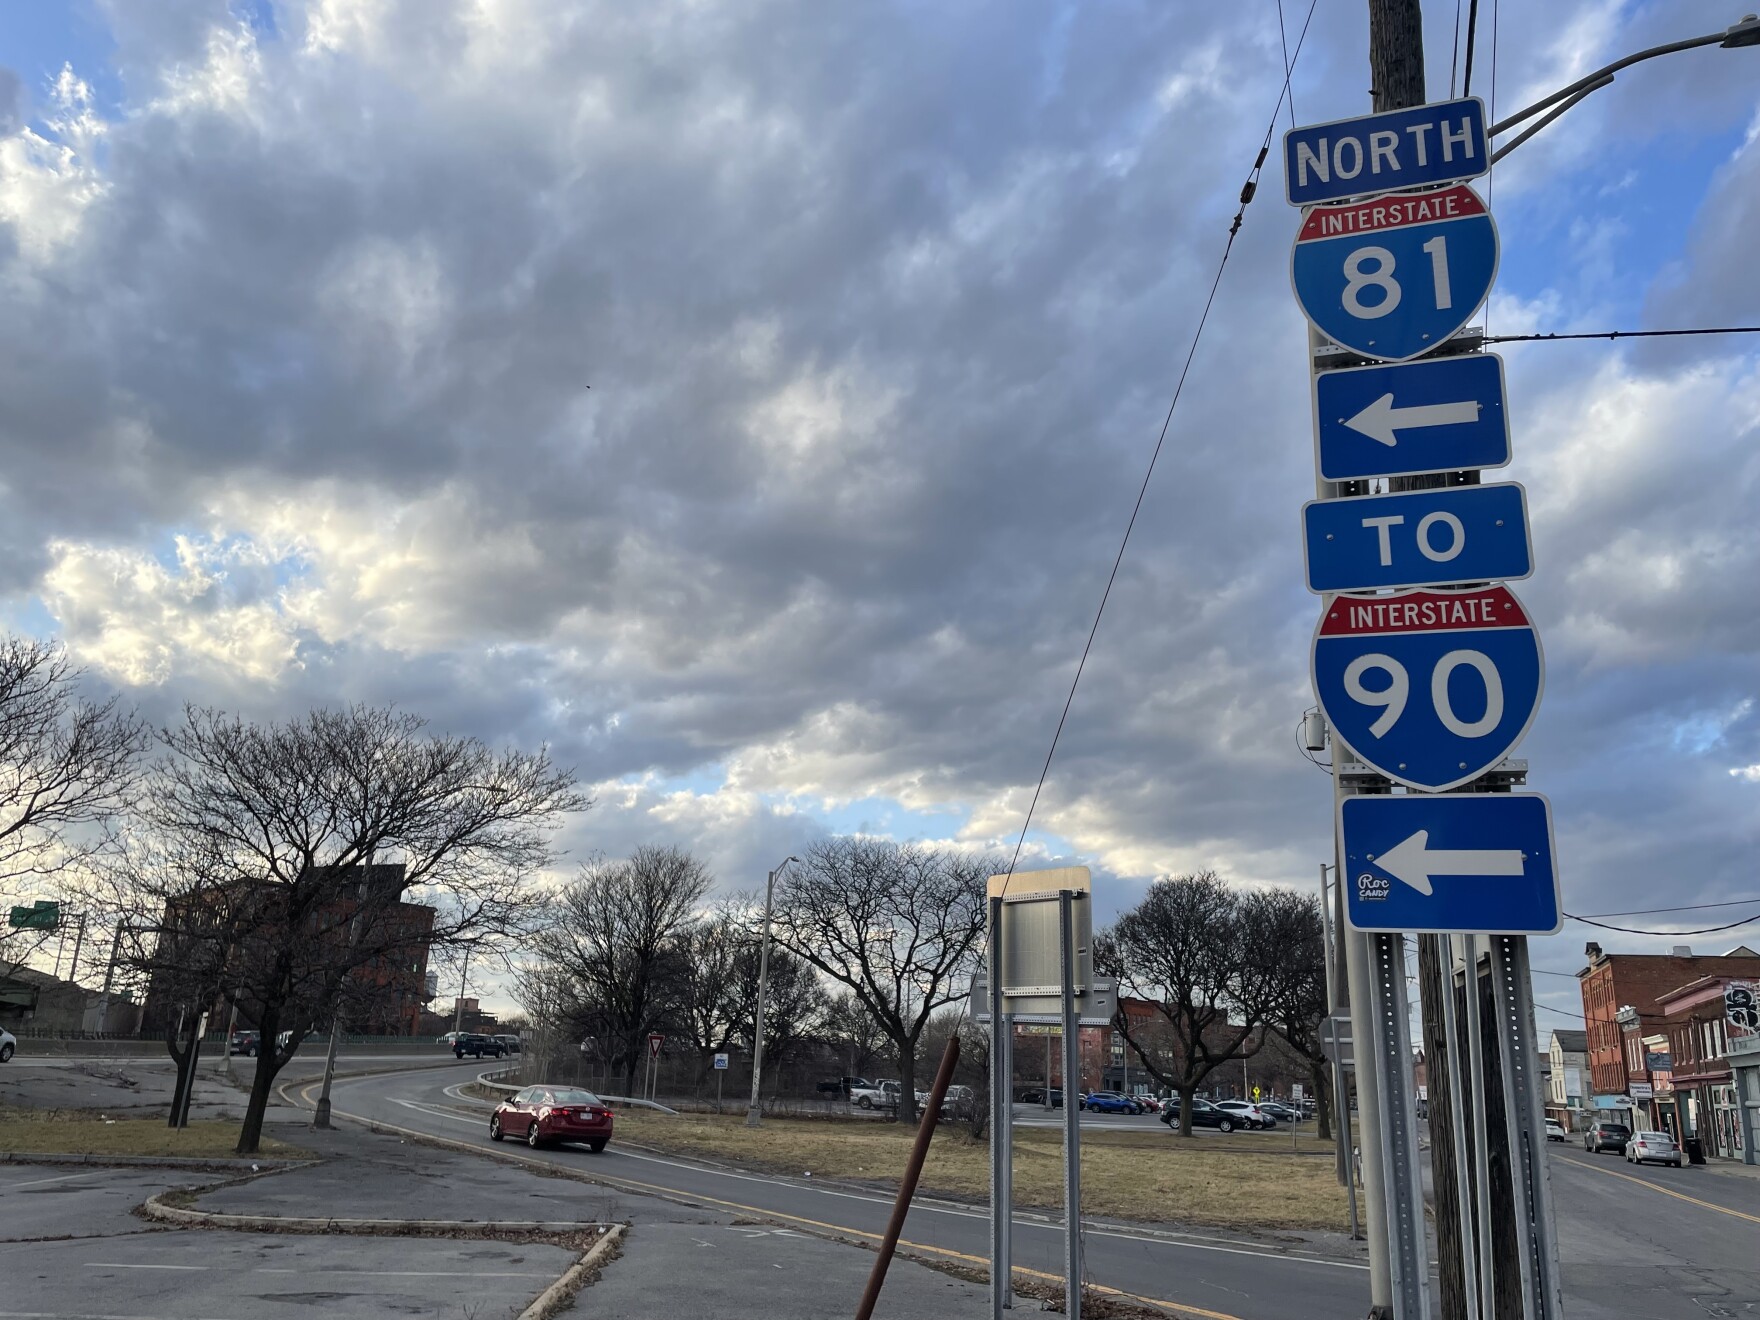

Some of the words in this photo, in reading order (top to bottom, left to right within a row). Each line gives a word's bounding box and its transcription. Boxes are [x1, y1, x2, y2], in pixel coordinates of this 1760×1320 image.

[1297, 117, 1475, 187] NORTH
[1321, 195, 1460, 235] INTERSTATE
[1342, 236, 1452, 320] 81
[1362, 511, 1465, 566] TO
[1350, 598, 1496, 628] INTERSTATE
[1344, 649, 1504, 739] 90
[1358, 873, 1389, 889] Roc
[1359, 889, 1389, 897] CANDY
